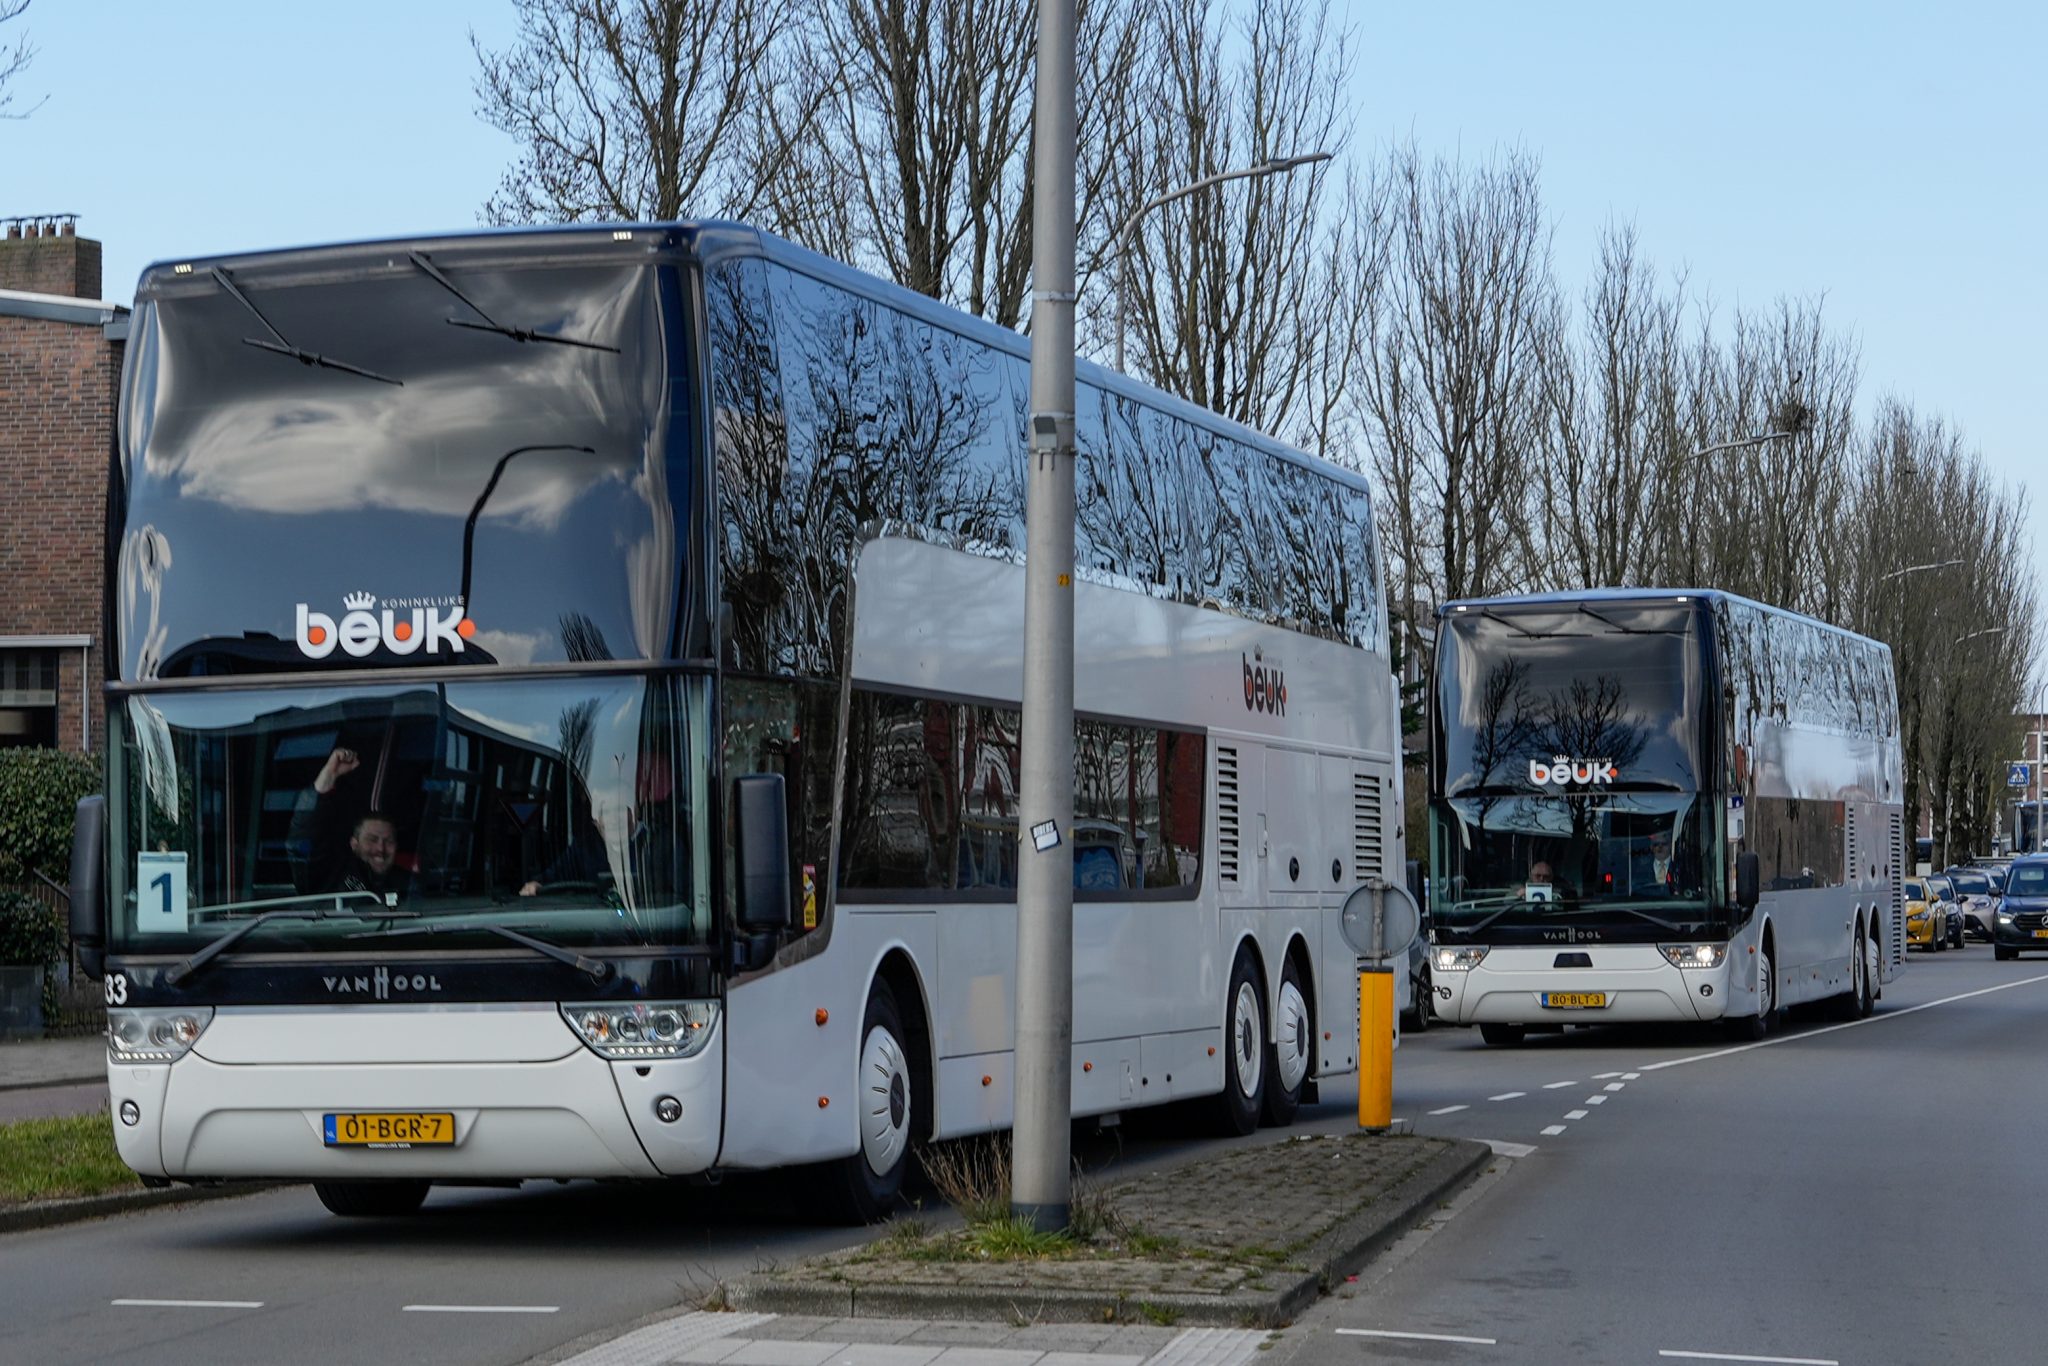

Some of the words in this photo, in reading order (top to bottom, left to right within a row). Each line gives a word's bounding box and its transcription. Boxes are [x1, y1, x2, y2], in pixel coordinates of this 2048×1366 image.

[381, 594, 465, 609] KONINKLIJKE
[151, 872, 172, 913] 1
[1552, 994, 1600, 1005] 80-BLT-3
[346, 1117, 442, 1139] 01-BGR-7
